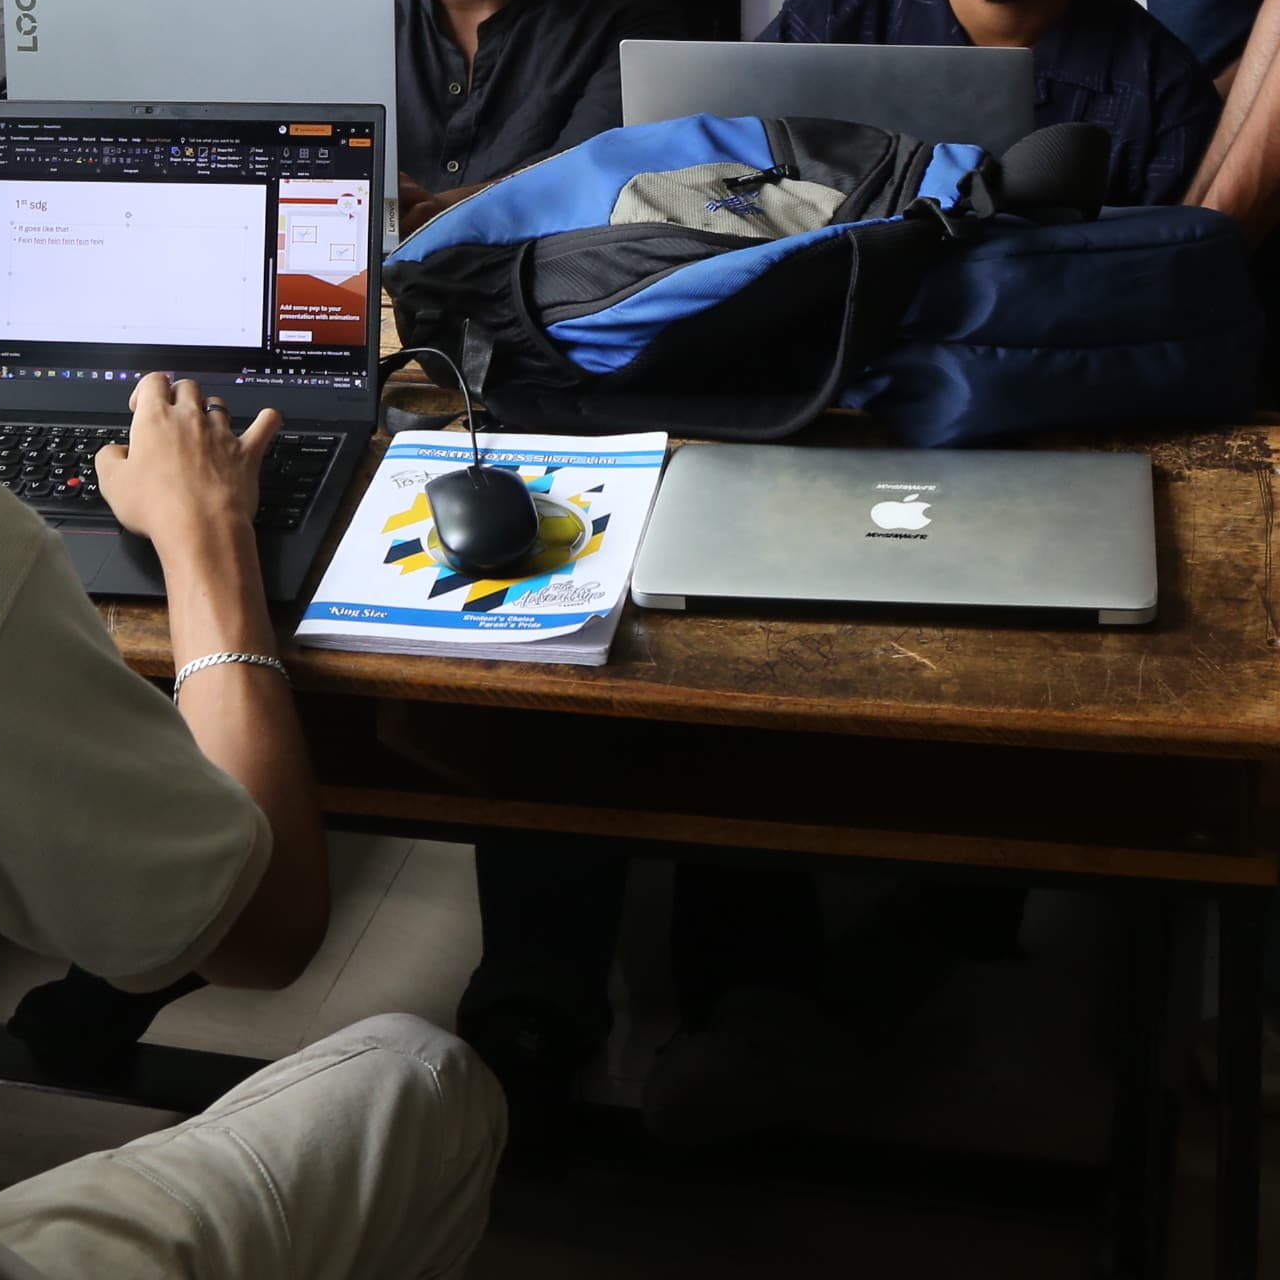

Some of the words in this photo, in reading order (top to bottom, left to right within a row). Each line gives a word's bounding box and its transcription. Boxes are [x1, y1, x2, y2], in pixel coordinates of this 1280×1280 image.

[29, 200, 48, 212] sdg
[388, 200, 396, 233] Lenovo
[532, 454, 578, 464] Silver
[585, 456, 617, 465] Line
[329, 606, 359, 617] King
[361, 608, 388, 618] Size
[507, 615, 535, 623] Choice
